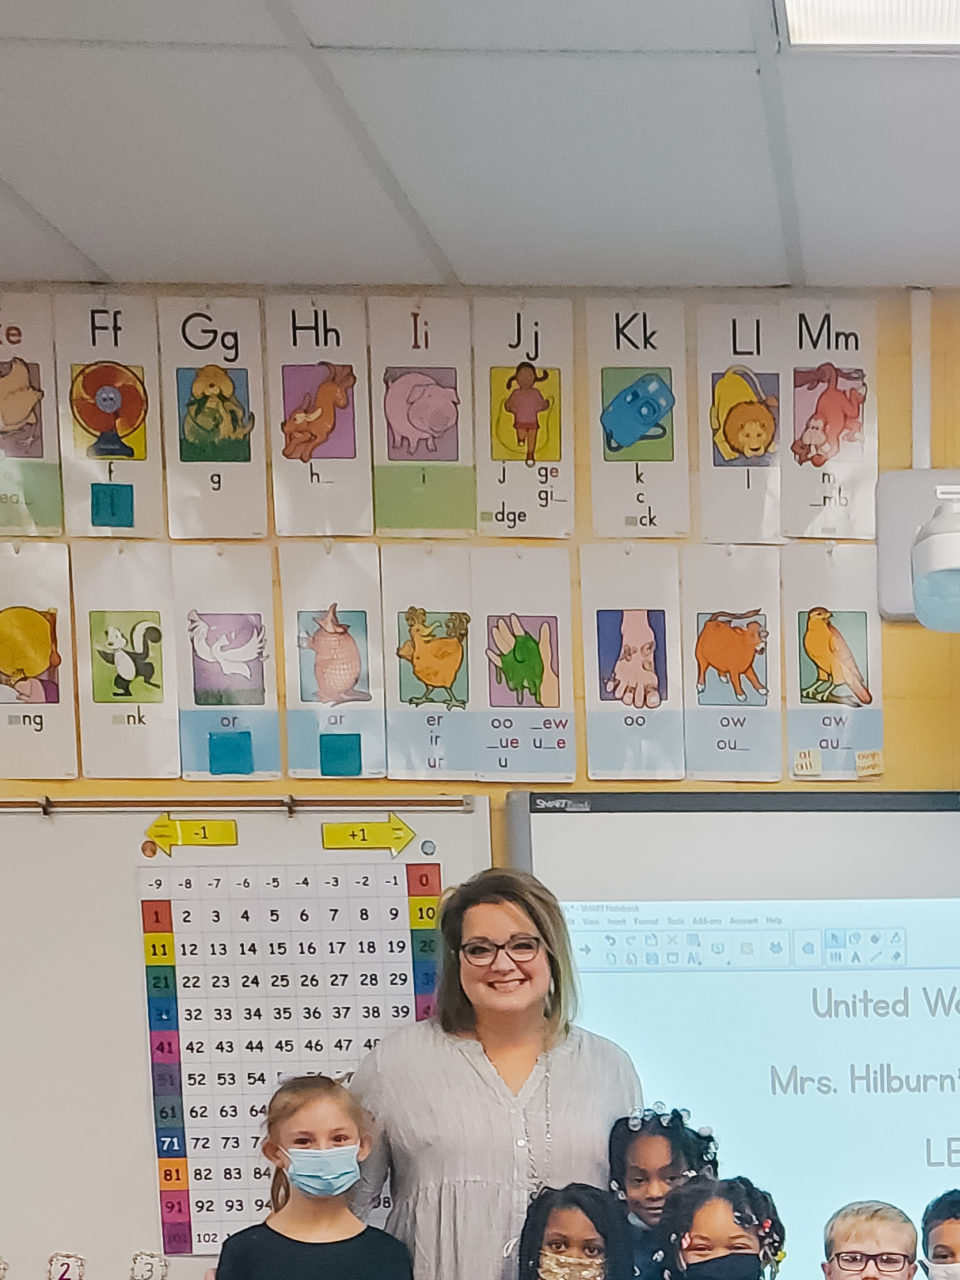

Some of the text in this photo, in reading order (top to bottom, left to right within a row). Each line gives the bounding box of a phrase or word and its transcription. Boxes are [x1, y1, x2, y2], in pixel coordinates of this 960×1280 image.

[90, 308, 123, 348] Ff
[291, 308, 341, 347] Hh
[410, 311, 429, 350] Ii
[614, 311, 657, 350] Kk
[798, 312, 859, 351] Mm
[181, 312, 239, 363] Gg
[507, 312, 539, 362] Jj
[731, 318, 761, 356] Ll
[537, 466, 559, 488] ge
[494, 501, 527, 529] dge
[639, 505, 657, 527] ck
[22, 714, 44, 733] ng
[126, 704, 147, 726] nk
[220, 716, 238, 728] or
[426, 715, 444, 727] er
[490, 718, 514, 729] oo
[624, 715, 646, 727] oo
[719, 716, 747, 728] ow
[348, 828, 368, 842] +1
[148, 878, 163, 890] -9
[178, 878, 192, 889] -8
[207, 878, 222, 889] -7
[236, 877, 251, 889] -6
[265, 877, 280, 889] -5
[295, 876, 310, 887] -4
[324, 876, 339, 888] -3
[355, 875, 370, 887] -2
[385, 875, 399, 886] -1
[153, 910, 161, 924] 1
[182, 910, 192, 923] 2
[211, 910, 221, 923] 3
[240, 909, 250, 922] 4
[270, 909, 280, 923] 5
[299, 908, 310, 923] 6
[329, 908, 339, 922] 7
[359, 908, 369, 921] 8
[389, 907, 399, 921] 9
[151, 940, 406, 957] 11 12 14 16 18 19
[152, 972, 408, 990] 21 22 24 26 28 29
[811, 985, 910, 1019] United
[185, 1040, 205, 1054] 42
[770, 1064, 838, 1096] Mrs.
[189, 1105, 209, 1119] 62
[160, 1137, 180, 1151] 71
[163, 1168, 213, 1182] 81 82
[195, 1199, 215, 1213] 92
[196, 1232, 218, 1244] 102
[59, 1263, 70, 1280] 2
